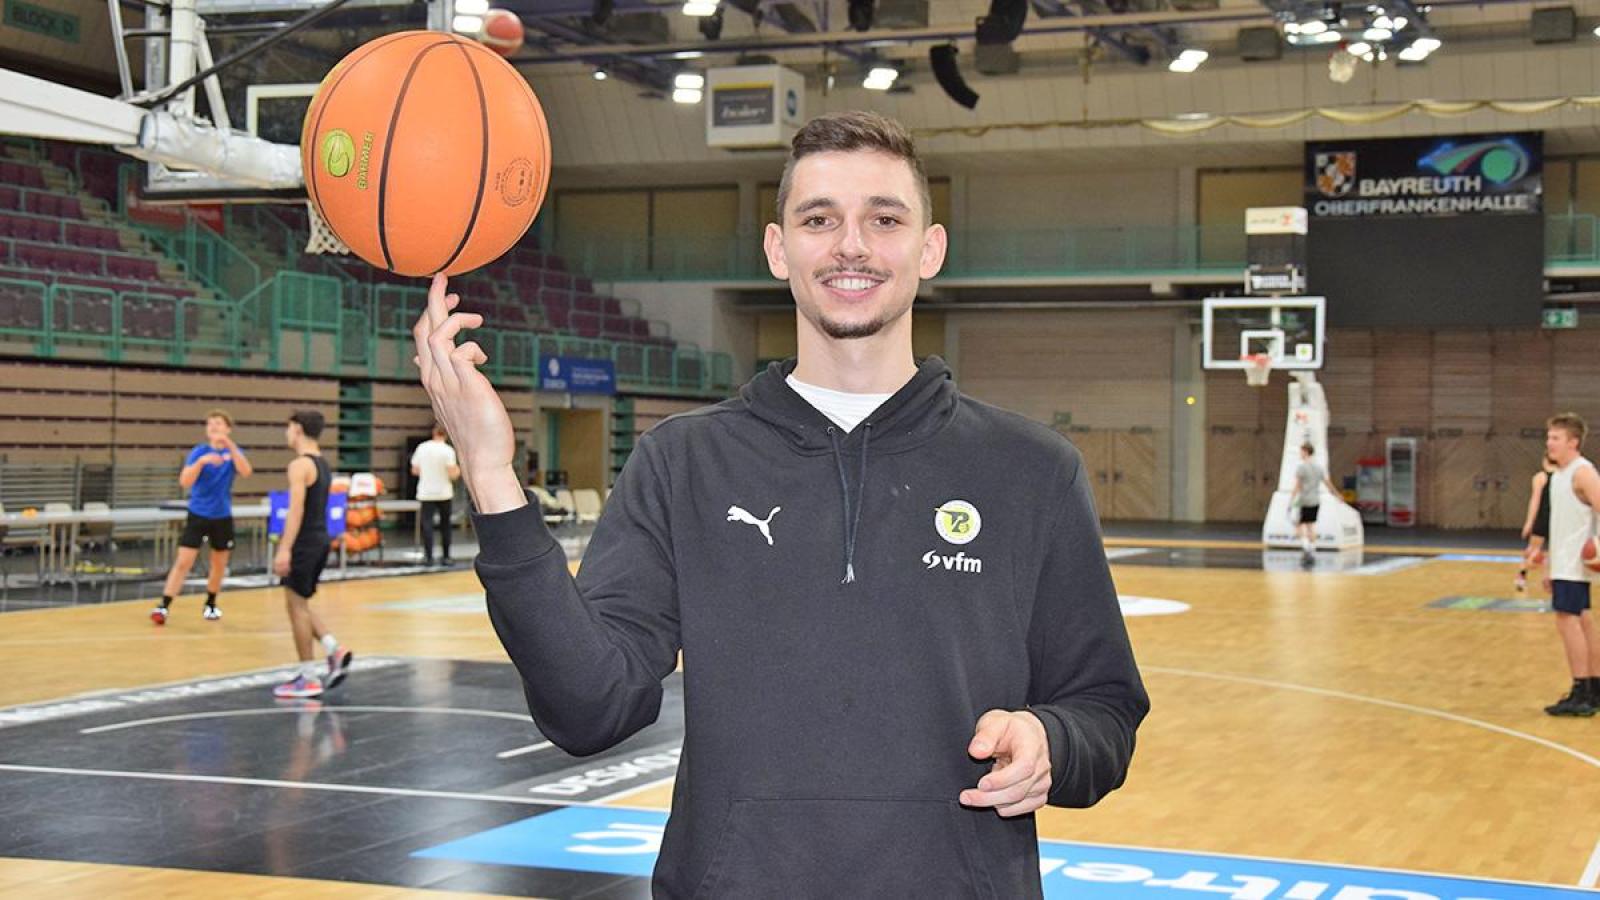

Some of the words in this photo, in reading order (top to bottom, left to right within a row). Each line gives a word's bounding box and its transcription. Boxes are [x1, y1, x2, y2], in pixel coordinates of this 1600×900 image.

[357, 131, 374, 190] BARMER
[1359, 175, 1481, 197] BAYREUTH
[1314, 194, 1529, 216] OBERFRANKENHALLE
[942, 551, 982, 573] vfm
